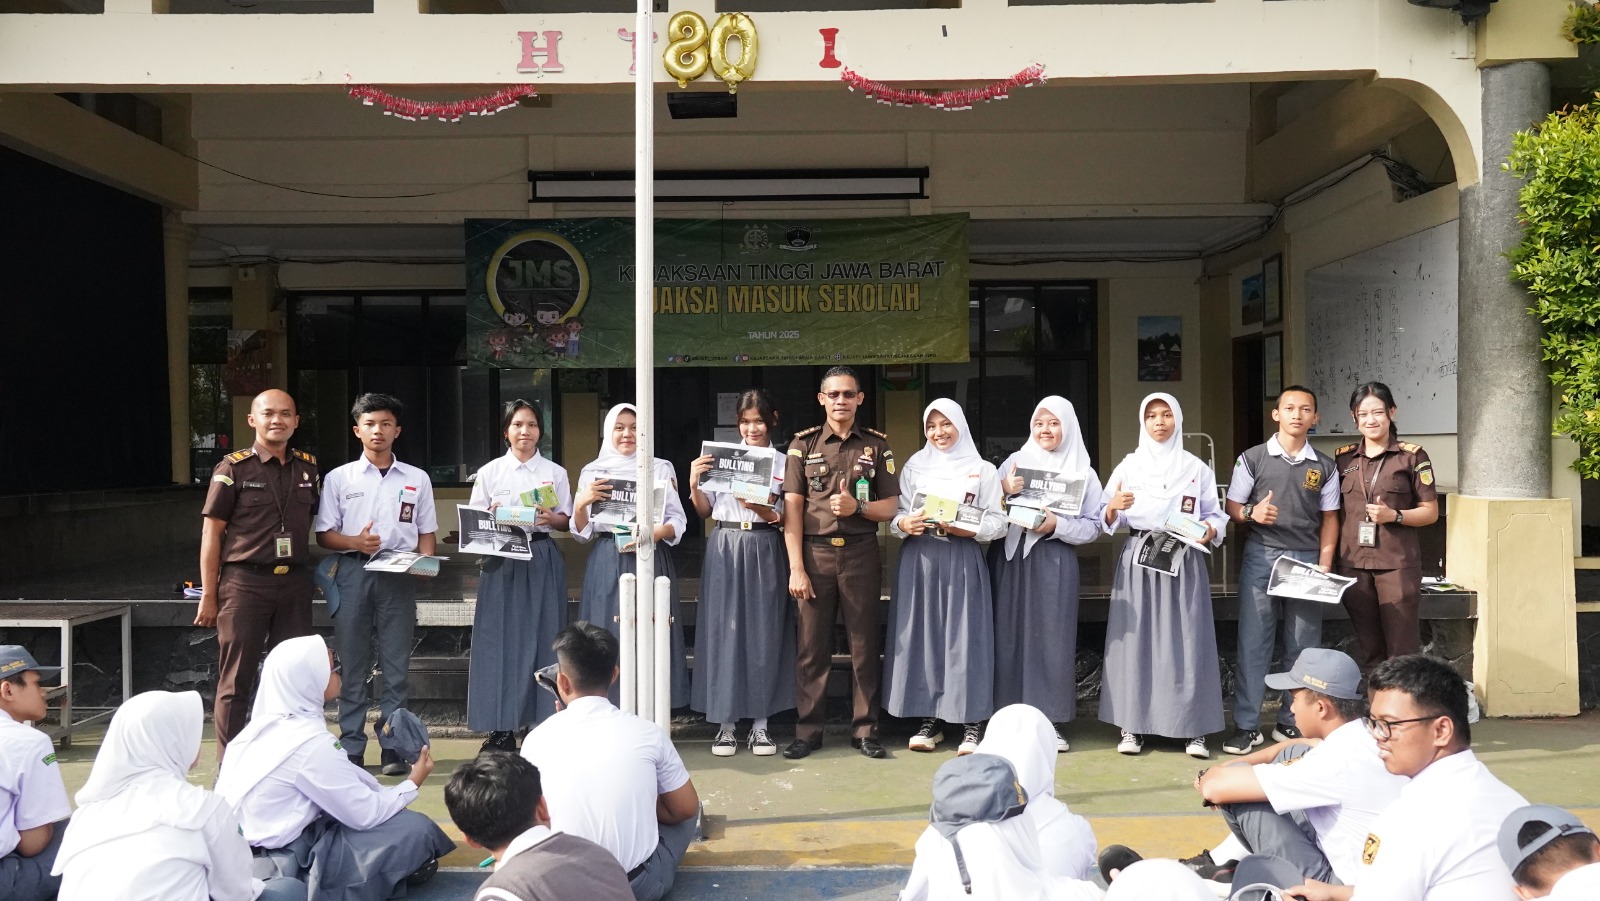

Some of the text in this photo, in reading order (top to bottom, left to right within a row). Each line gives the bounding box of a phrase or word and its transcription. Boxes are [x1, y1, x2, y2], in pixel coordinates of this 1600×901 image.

[517, 30, 565, 73] H
[505, 259, 573, 288] JMS
[747, 263, 814, 281] TINGGI
[820, 261, 873, 280] JAWA
[879, 261, 945, 279] BARAT
[727, 284, 811, 314] MASUK
[818, 282, 921, 312] SEKOLAH
[748, 330, 800, 339] TAHUN 2025
[719, 458, 755, 472] BULLYING
[1029, 478, 1067, 493] BULLYING
